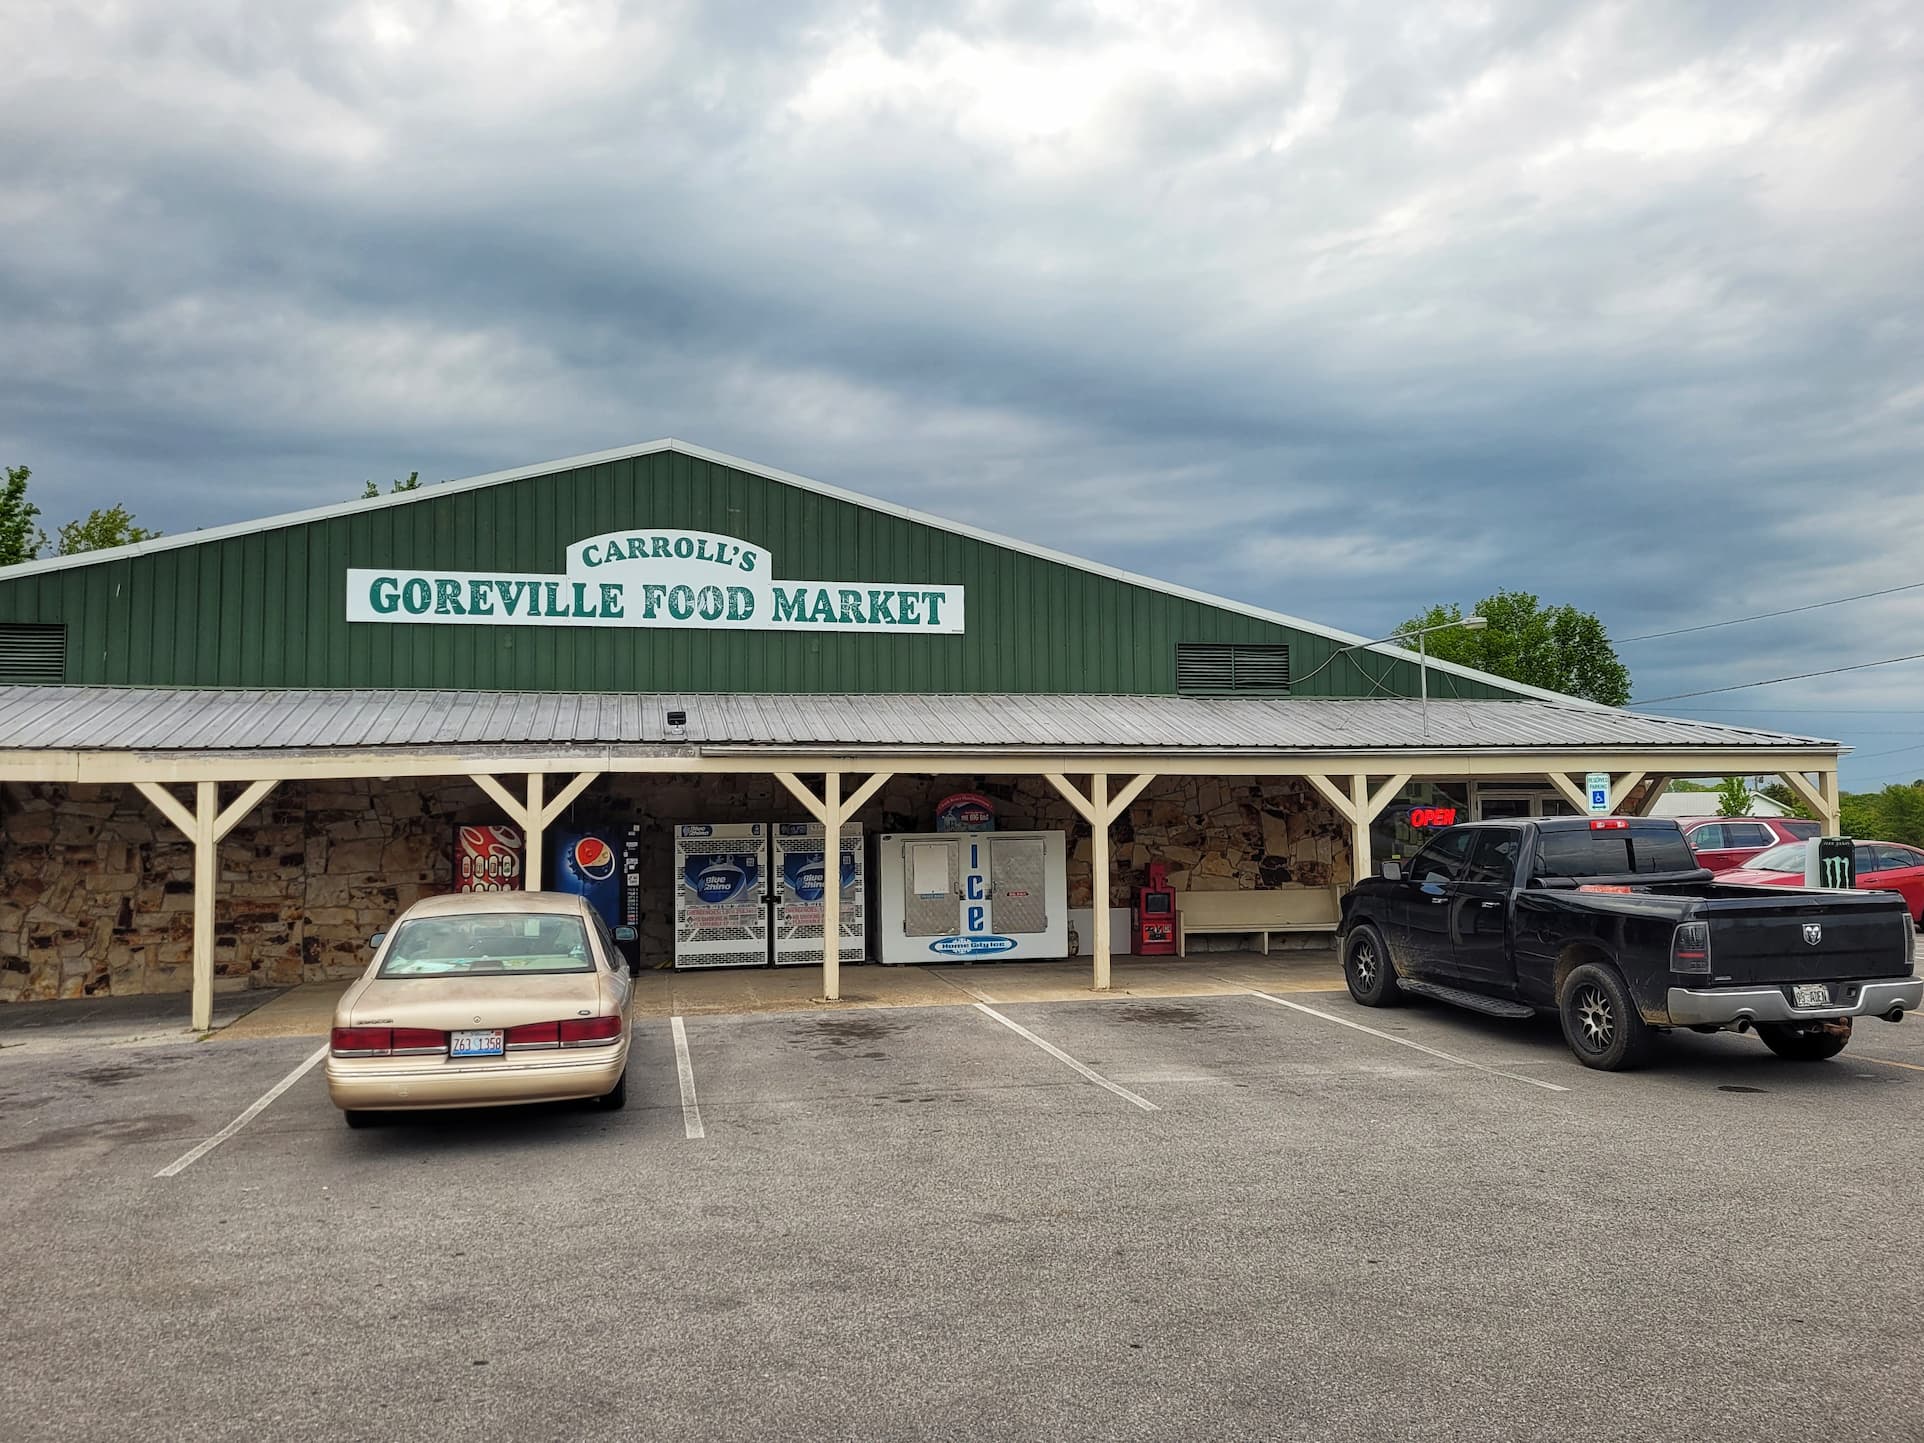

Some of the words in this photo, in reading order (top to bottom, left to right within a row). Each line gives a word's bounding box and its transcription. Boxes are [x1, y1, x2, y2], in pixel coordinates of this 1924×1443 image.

[582, 536, 757, 572] CARROLL'S
[369, 577, 624, 618] GOREVILLE
[642, 584, 755, 621] FOOD
[772, 587, 946, 625] MARKET
[1411, 807, 1456, 827] OPEN
[802, 881, 825, 889] Rhin
[803, 874, 823, 882] Blue
[704, 883, 731, 891] Rhino
[478, 1037, 501, 1051] 1358
